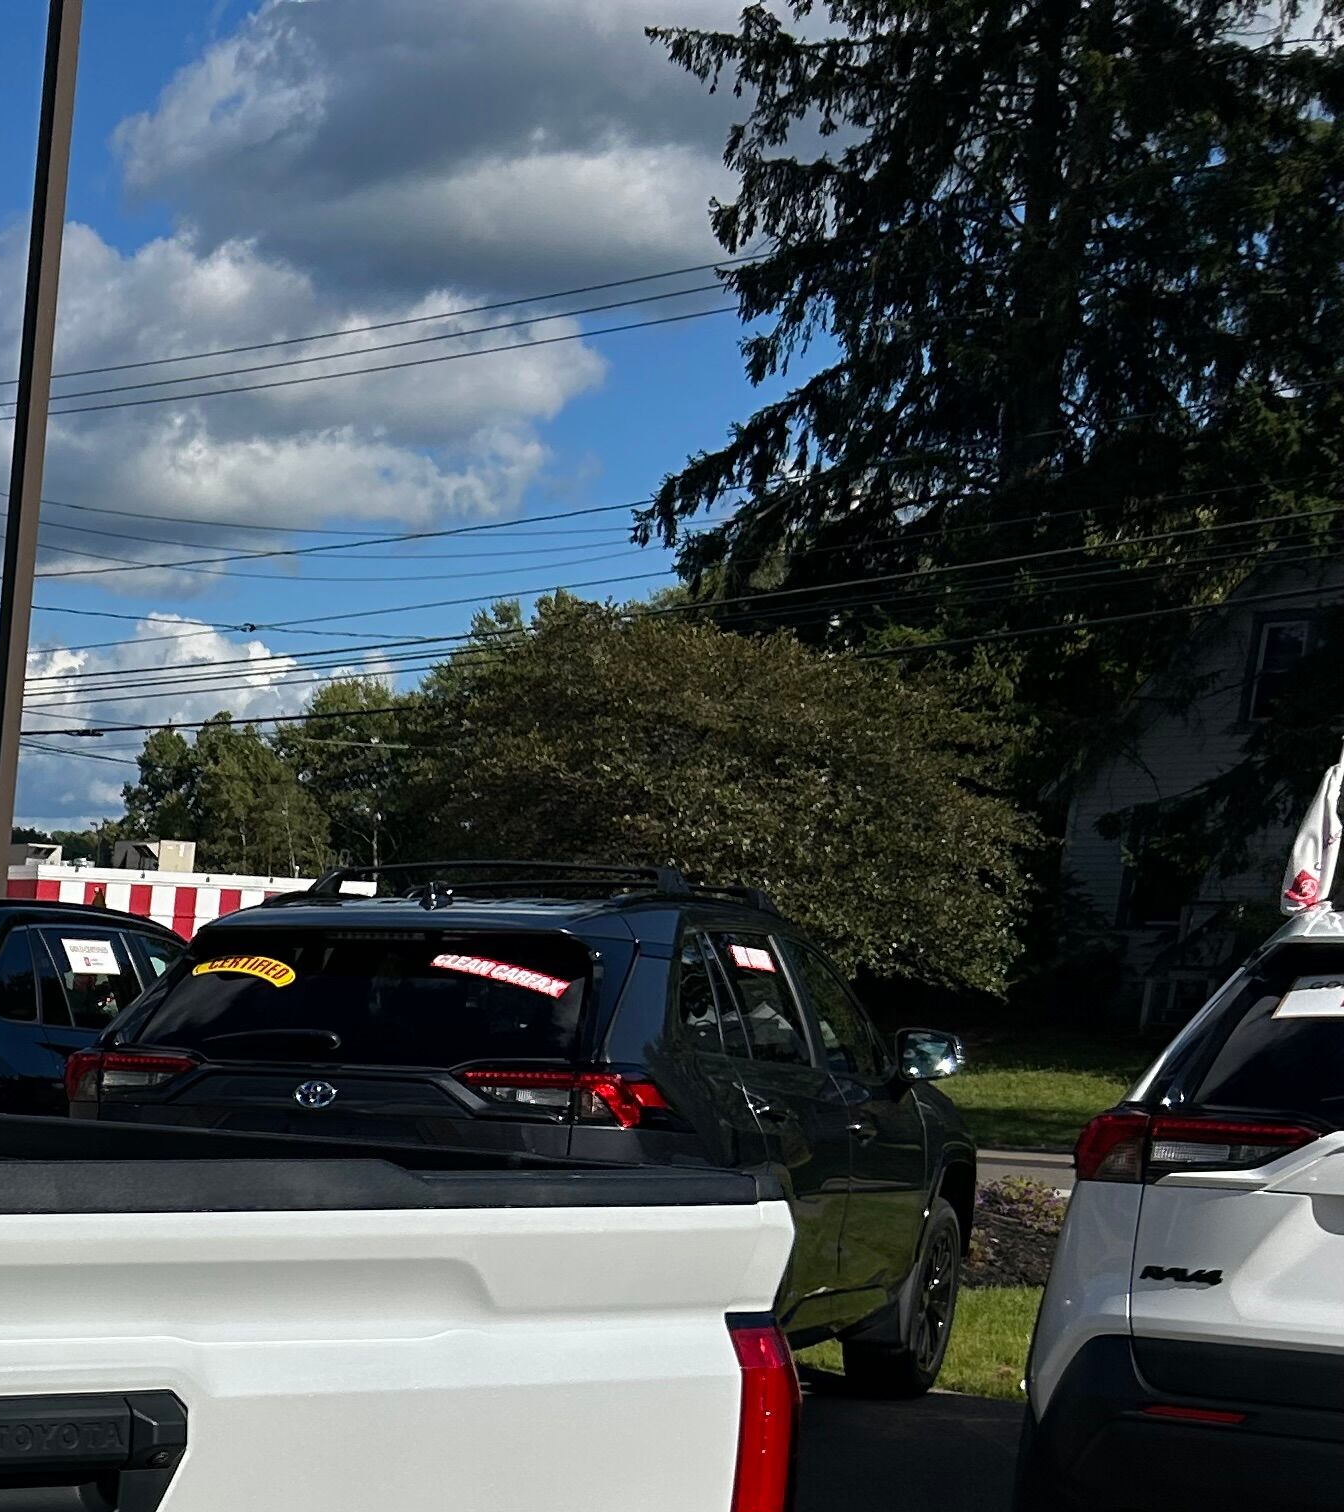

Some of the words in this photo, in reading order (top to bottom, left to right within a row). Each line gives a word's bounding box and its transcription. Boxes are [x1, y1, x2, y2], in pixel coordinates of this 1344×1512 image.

[207, 957, 290, 980] CERTIFIED
[431, 954, 497, 977] CLEAN
[490, 964, 571, 999] CARFAX
[1139, 1265, 1224, 1287] RAV4
